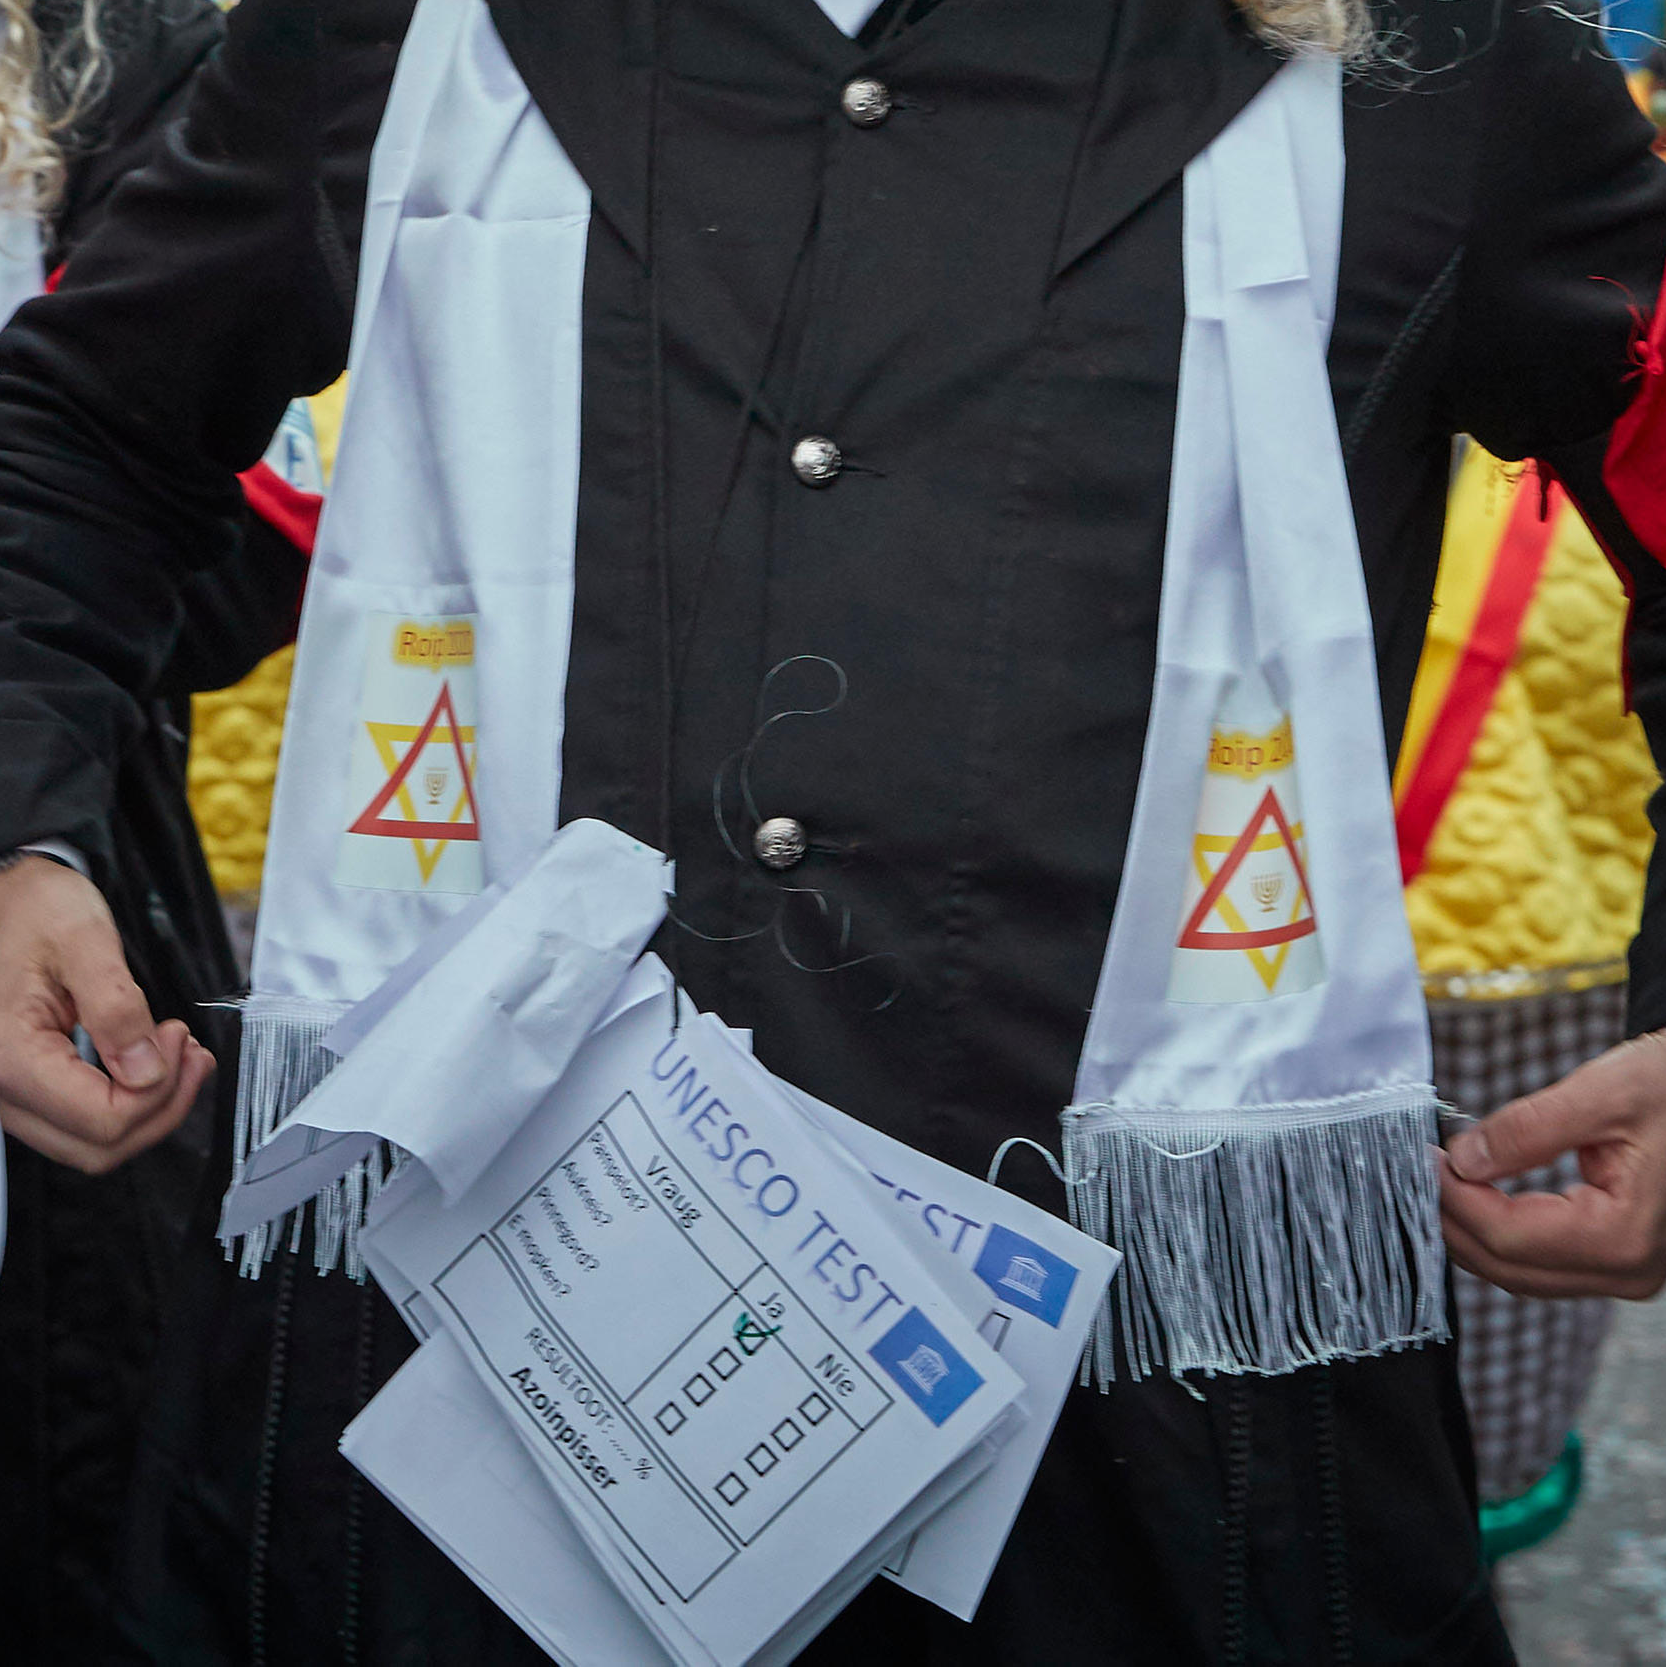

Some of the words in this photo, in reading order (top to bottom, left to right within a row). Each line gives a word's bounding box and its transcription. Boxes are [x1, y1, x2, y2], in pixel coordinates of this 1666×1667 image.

[645, 1154, 704, 1230] Vraug
[651, 1038, 800, 1217] UNESCO
[795, 1209, 904, 1327] TEST
[524, 1326, 615, 1434] RESULTOOT:
[758, 1291, 786, 1320] Ja
[814, 1352, 856, 1398] Nie
[509, 1366, 619, 1489] Azoinpisser
